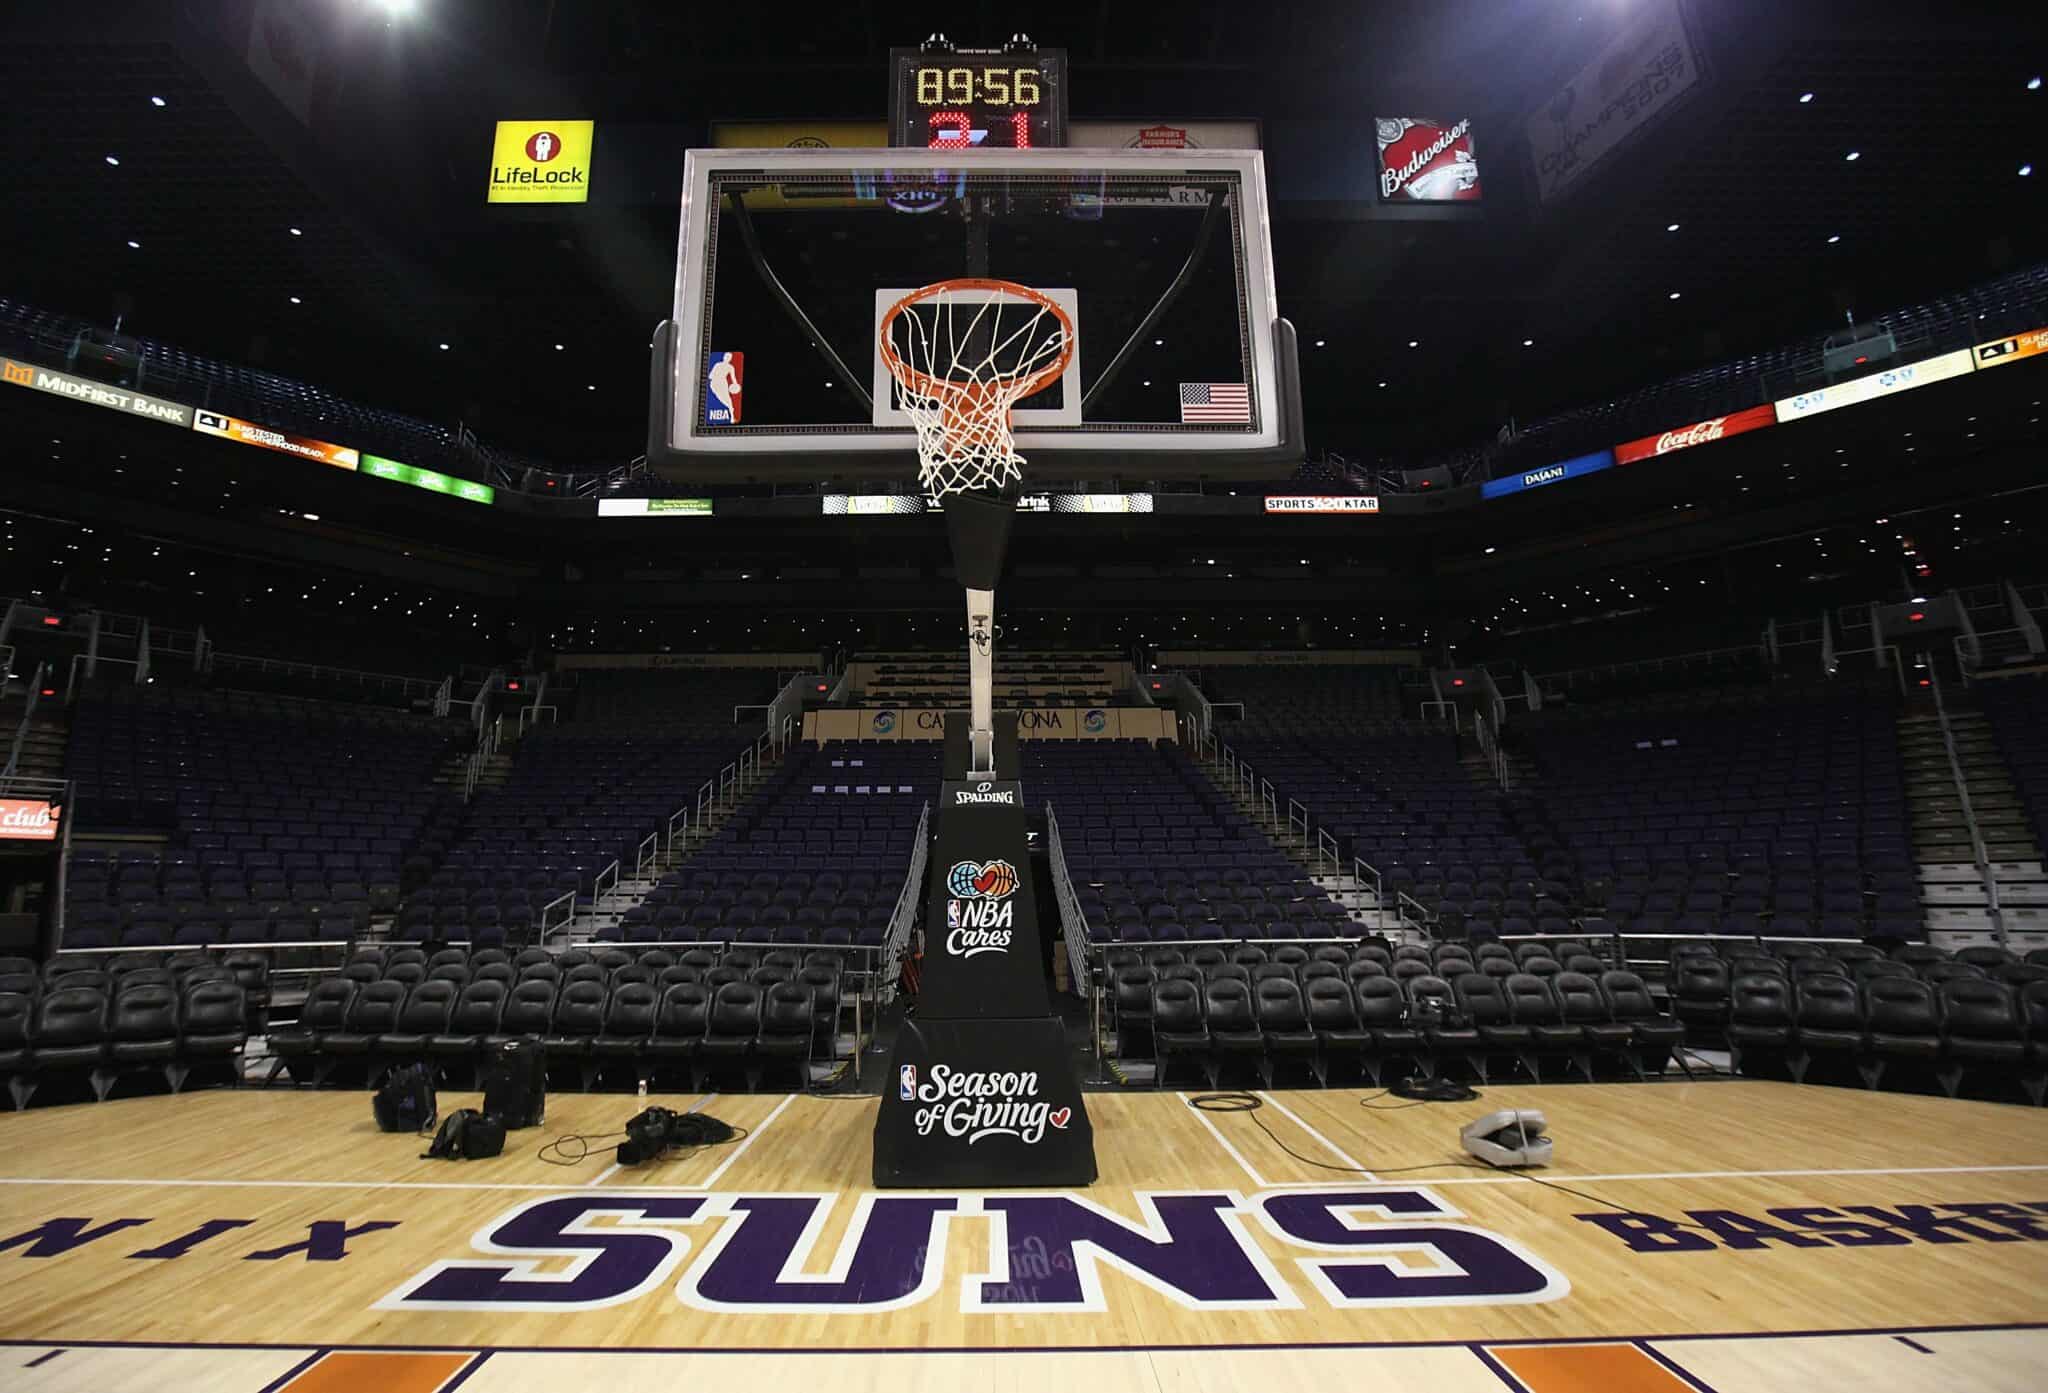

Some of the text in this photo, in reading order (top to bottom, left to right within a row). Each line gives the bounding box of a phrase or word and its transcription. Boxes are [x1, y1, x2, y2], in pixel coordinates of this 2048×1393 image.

[917, 67, 1040, 105] 89:56
[1380, 118, 1471, 198] Budweiser
[493, 166, 584, 184] LifeLock
[133, 398, 184, 423] BANK
[709, 409, 731, 421] NBA
[1655, 416, 1728, 456] Coca-Cola
[1524, 466, 1564, 486] DASANI
[1268, 499, 1315, 509] SPORTS
[1344, 499, 1376, 508] KTAR
[955, 790, 1015, 805] SPALDING
[3, 807, 50, 826] club
[961, 900, 1014, 928] NBA
[946, 927, 1013, 956] Cares
[918, 1064, 1039, 1103] Season
[914, 1097, 1051, 1144] of Giving
[369, 1190, 1571, 1315] SUNS
